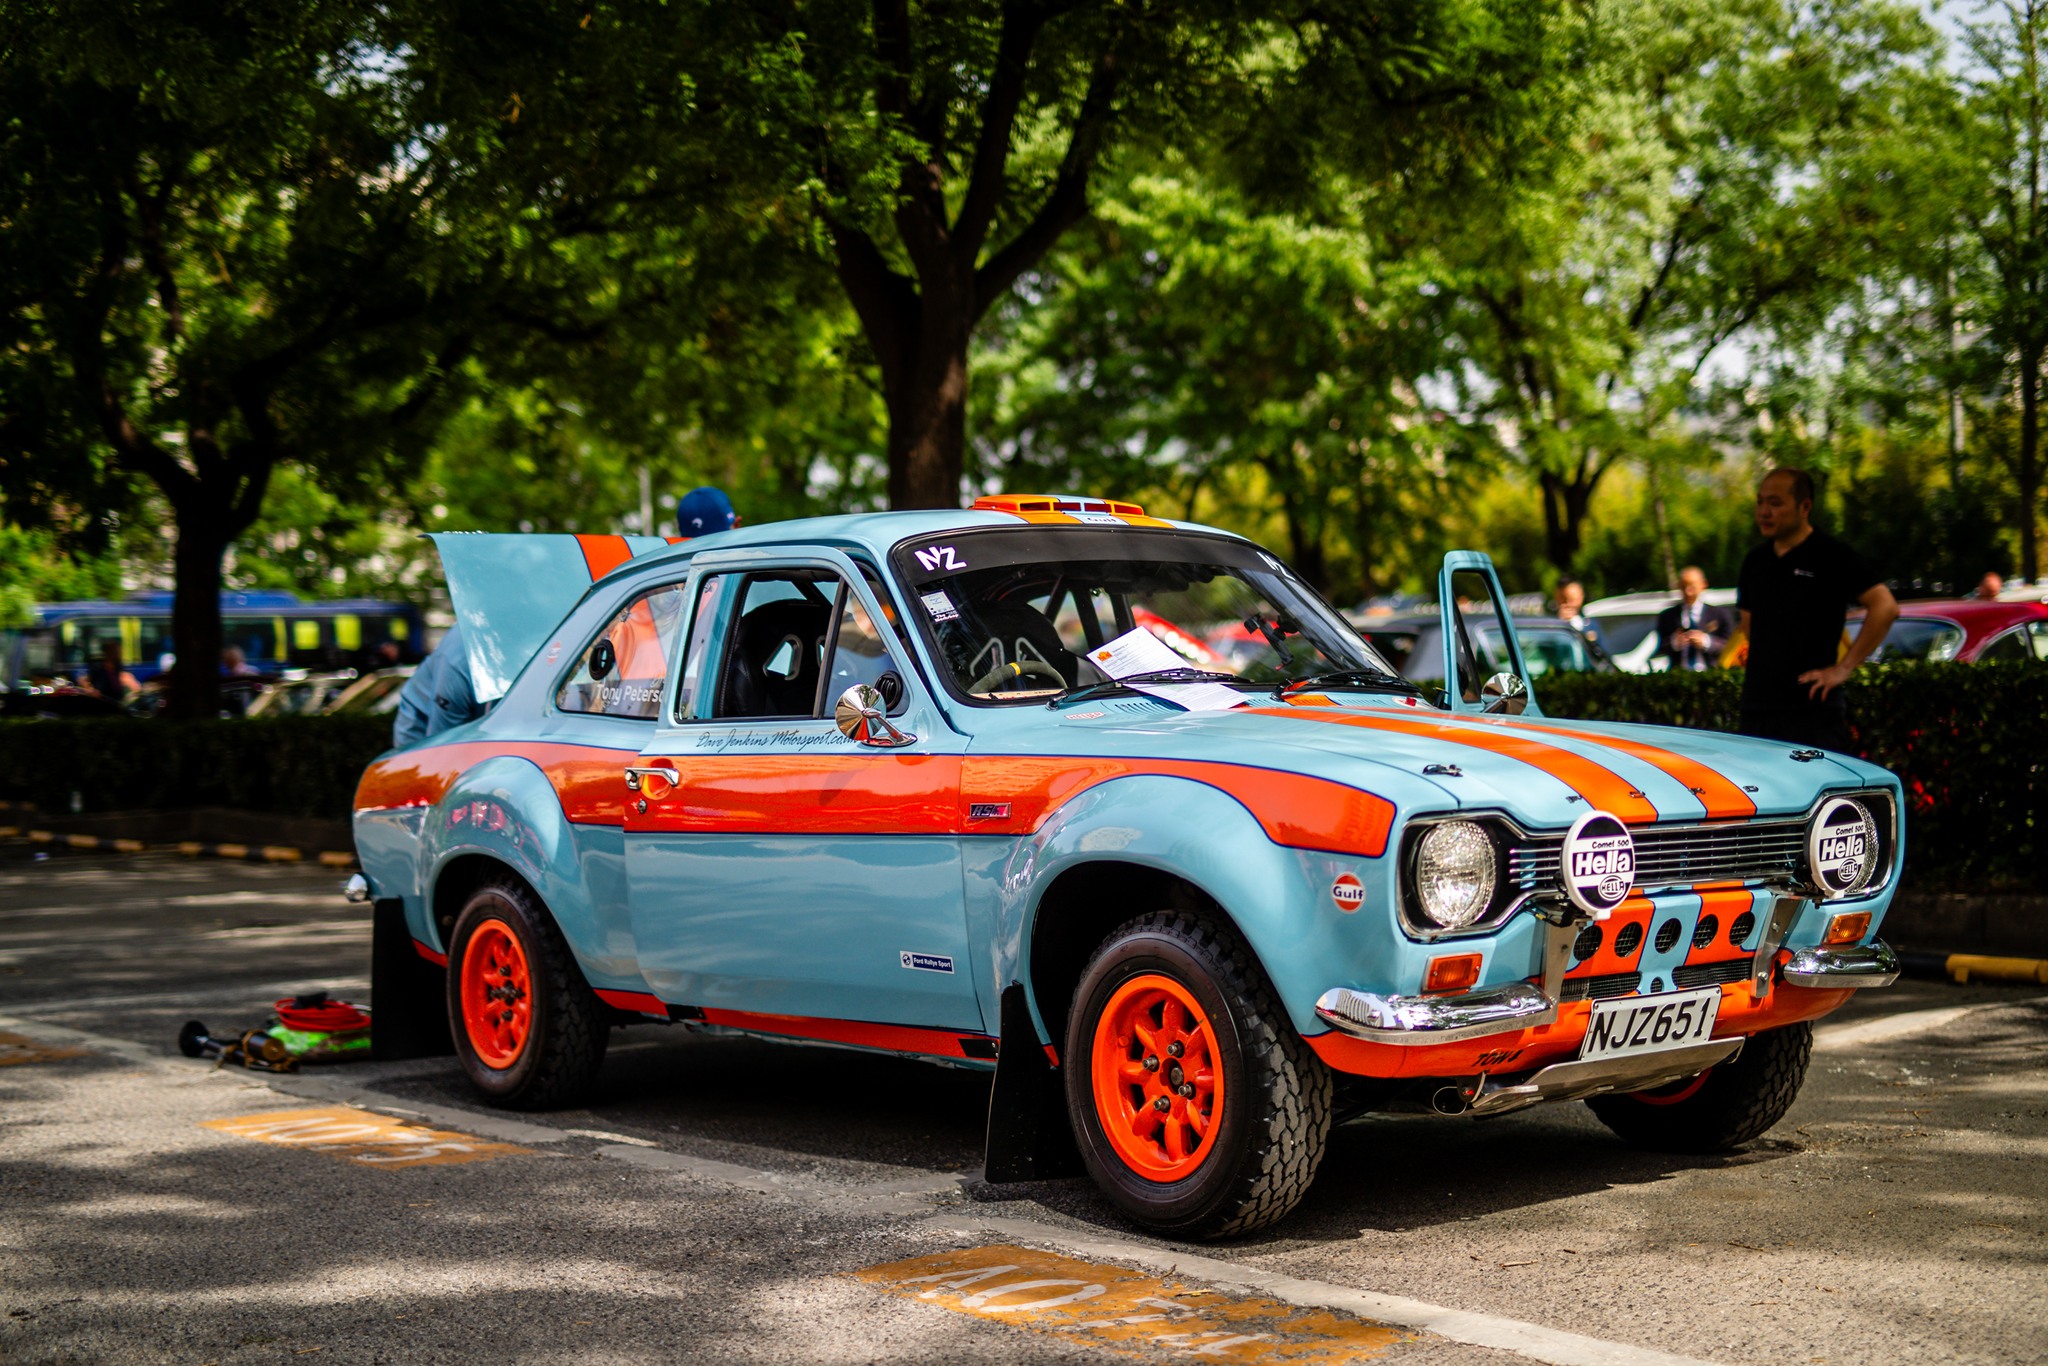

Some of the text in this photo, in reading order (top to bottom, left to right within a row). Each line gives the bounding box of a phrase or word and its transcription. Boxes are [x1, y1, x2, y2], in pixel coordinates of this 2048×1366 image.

[914, 546, 967, 571] NZ
[597, 683, 622, 706] Tony
[696, 731, 724, 748] Dave
[718, 728, 768, 753] Jenkins
[1836, 827, 1854, 835] Comet
[1592, 839, 1630, 849] Comet 500
[1821, 835, 1864, 860] Hella
[1575, 850, 1630, 876] Hella
[1840, 864, 1857, 873] HELLA
[1333, 886, 1364, 900] Gulf
[1601, 881, 1625, 892] HELLA
[913, 957, 924, 965] Ford
[938, 960, 951, 968] Sport
[1588, 997, 1711, 1054] NJZ651
[1471, 1050, 1515, 1067] TOW
